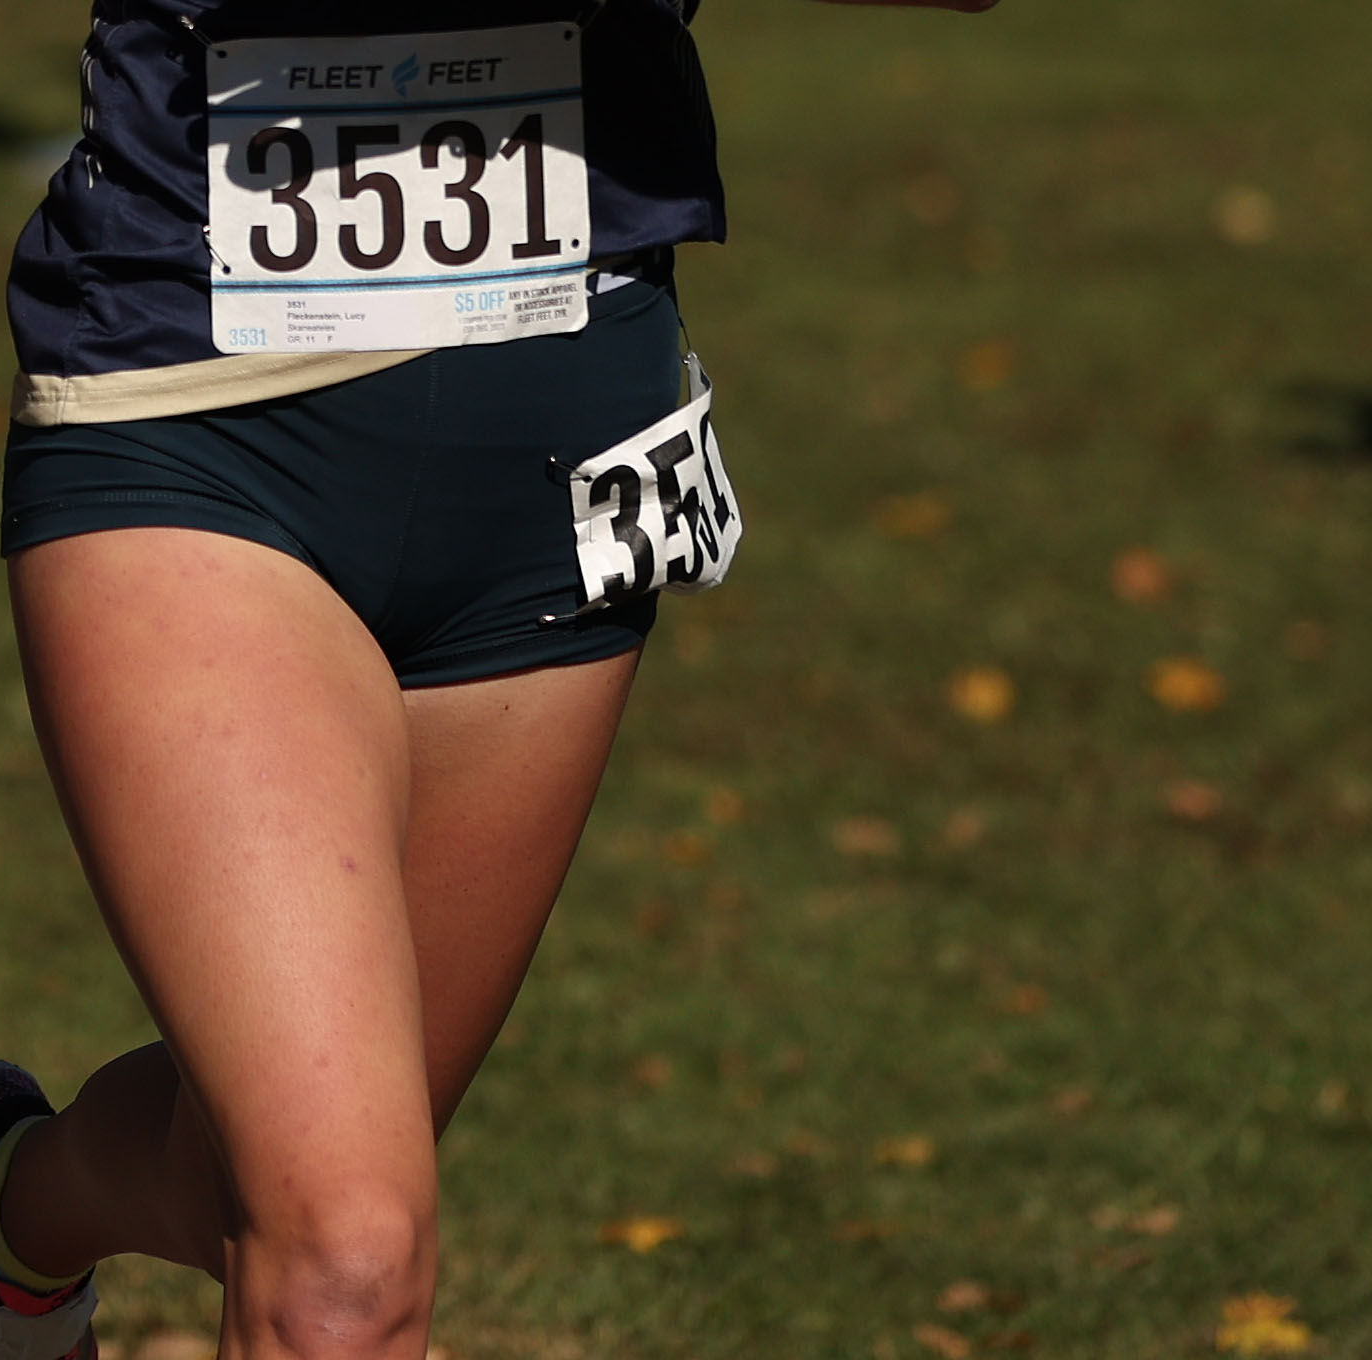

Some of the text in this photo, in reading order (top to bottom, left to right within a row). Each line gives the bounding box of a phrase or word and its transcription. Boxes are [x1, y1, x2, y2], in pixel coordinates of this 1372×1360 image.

[289, 58, 503, 90] FLEET FEET
[247, 114, 561, 273] 3531
[455, 290, 506, 313] $5 OFF
[345, 312, 366, 322] Lucy
[229, 328, 268, 346] 3531
